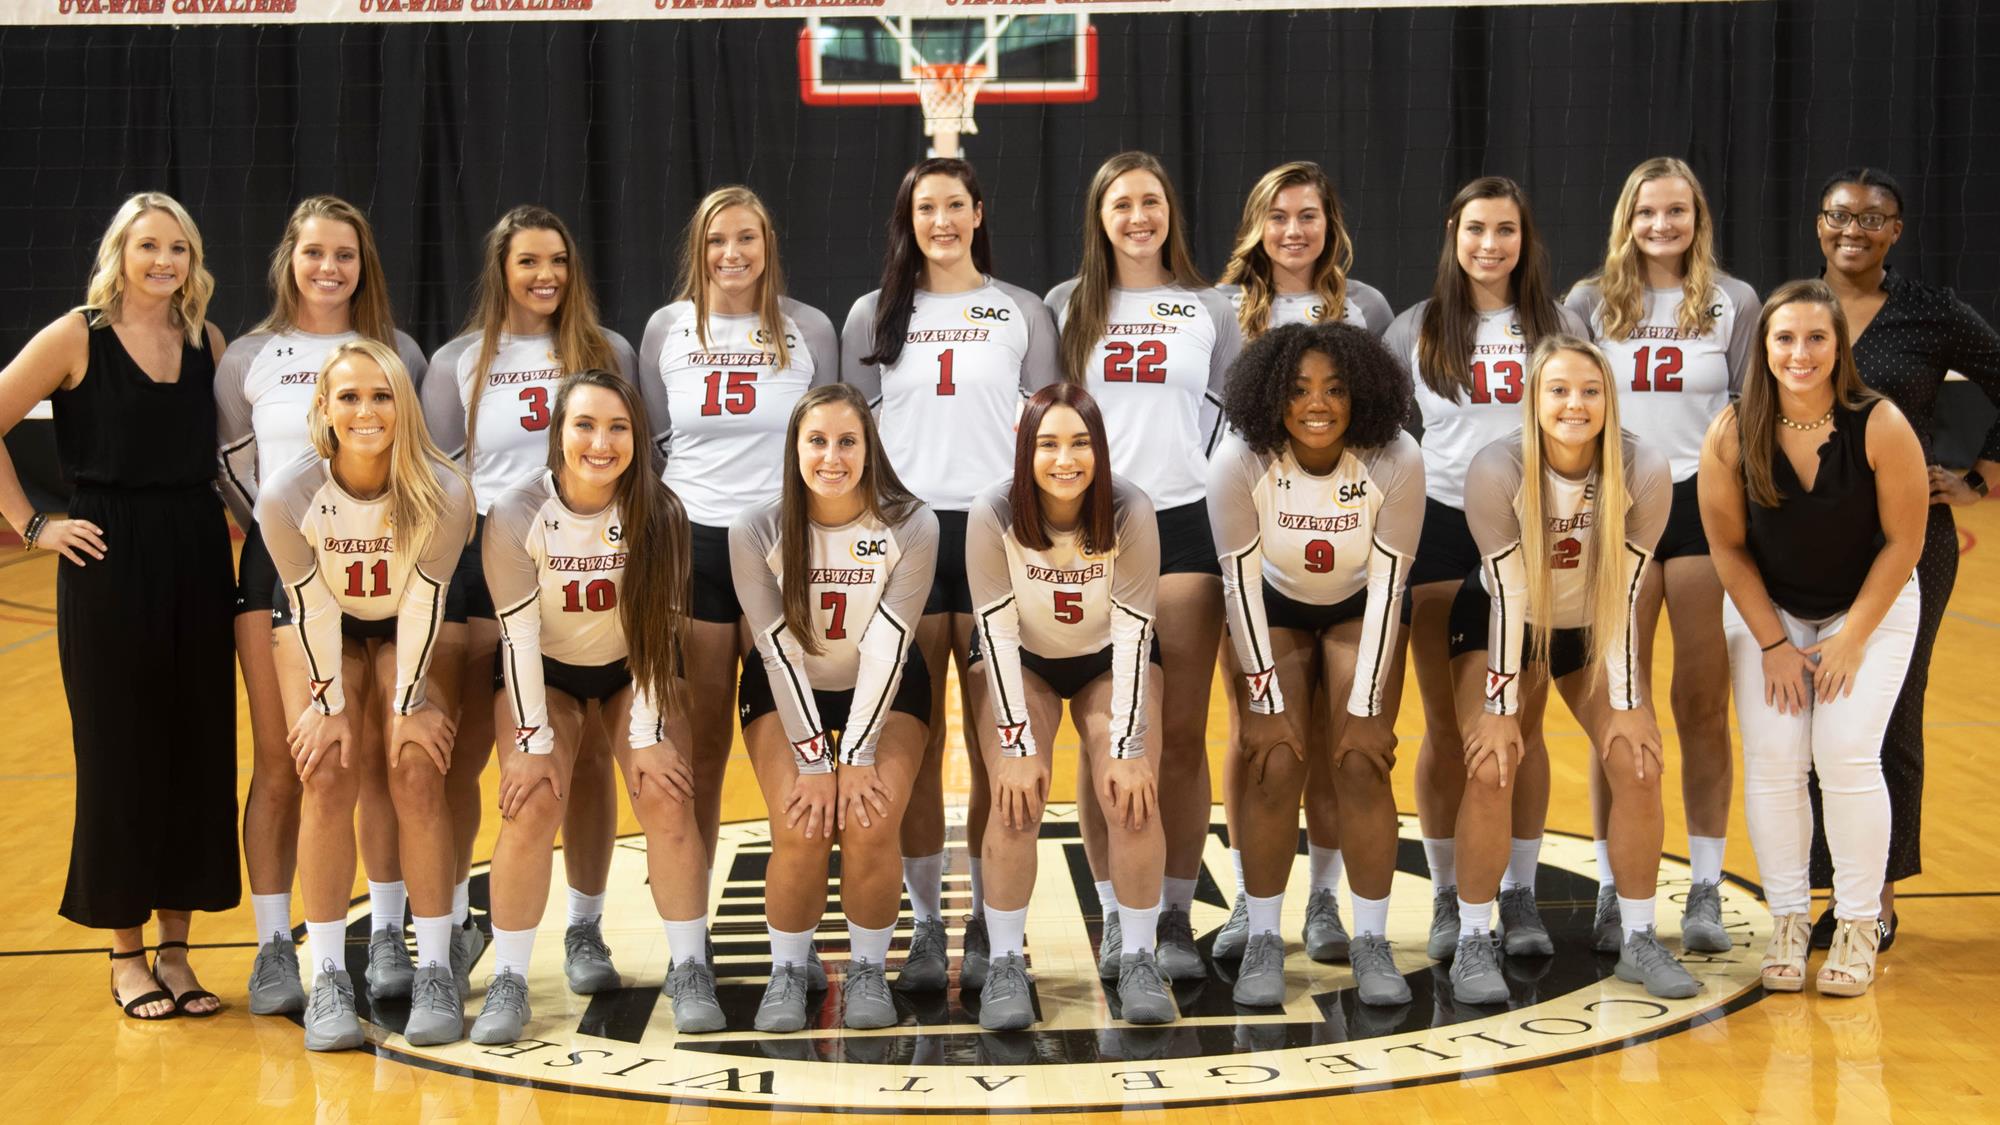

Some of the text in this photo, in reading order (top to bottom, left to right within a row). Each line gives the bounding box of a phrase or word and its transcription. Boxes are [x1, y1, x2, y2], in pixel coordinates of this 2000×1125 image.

[971, 306, 1011, 322] SAC
[1157, 303, 1196, 318] SAC
[756, 329, 797, 349] SC
[1105, 323, 1178, 335] VA-WISE
[489, 368, 565, 386] UVA-WIS
[936, 348, 956, 396] 1
[1104, 340, 1168, 384] 22
[1631, 346, 1683, 392] 12
[701, 371, 758, 416] 15
[1470, 361, 1525, 404] 13
[519, 386, 551, 432] 3
[1339, 480, 1368, 502] SAC
[1278, 511, 1359, 534] UVA-WISE
[324, 537, 394, 554] UVA-WIS
[856, 539, 887, 556] SAC
[1304, 539, 1335, 573] 9
[1551, 537, 1582, 569] 2
[344, 559, 391, 597] 11
[1026, 563, 1104, 585] UVA-WISE
[562, 578, 617, 612] 10
[1053, 590, 1083, 624] 5
[821, 591, 847, 640] 7
[482, 1000, 1669, 1095] COLLEGE AT WISE
